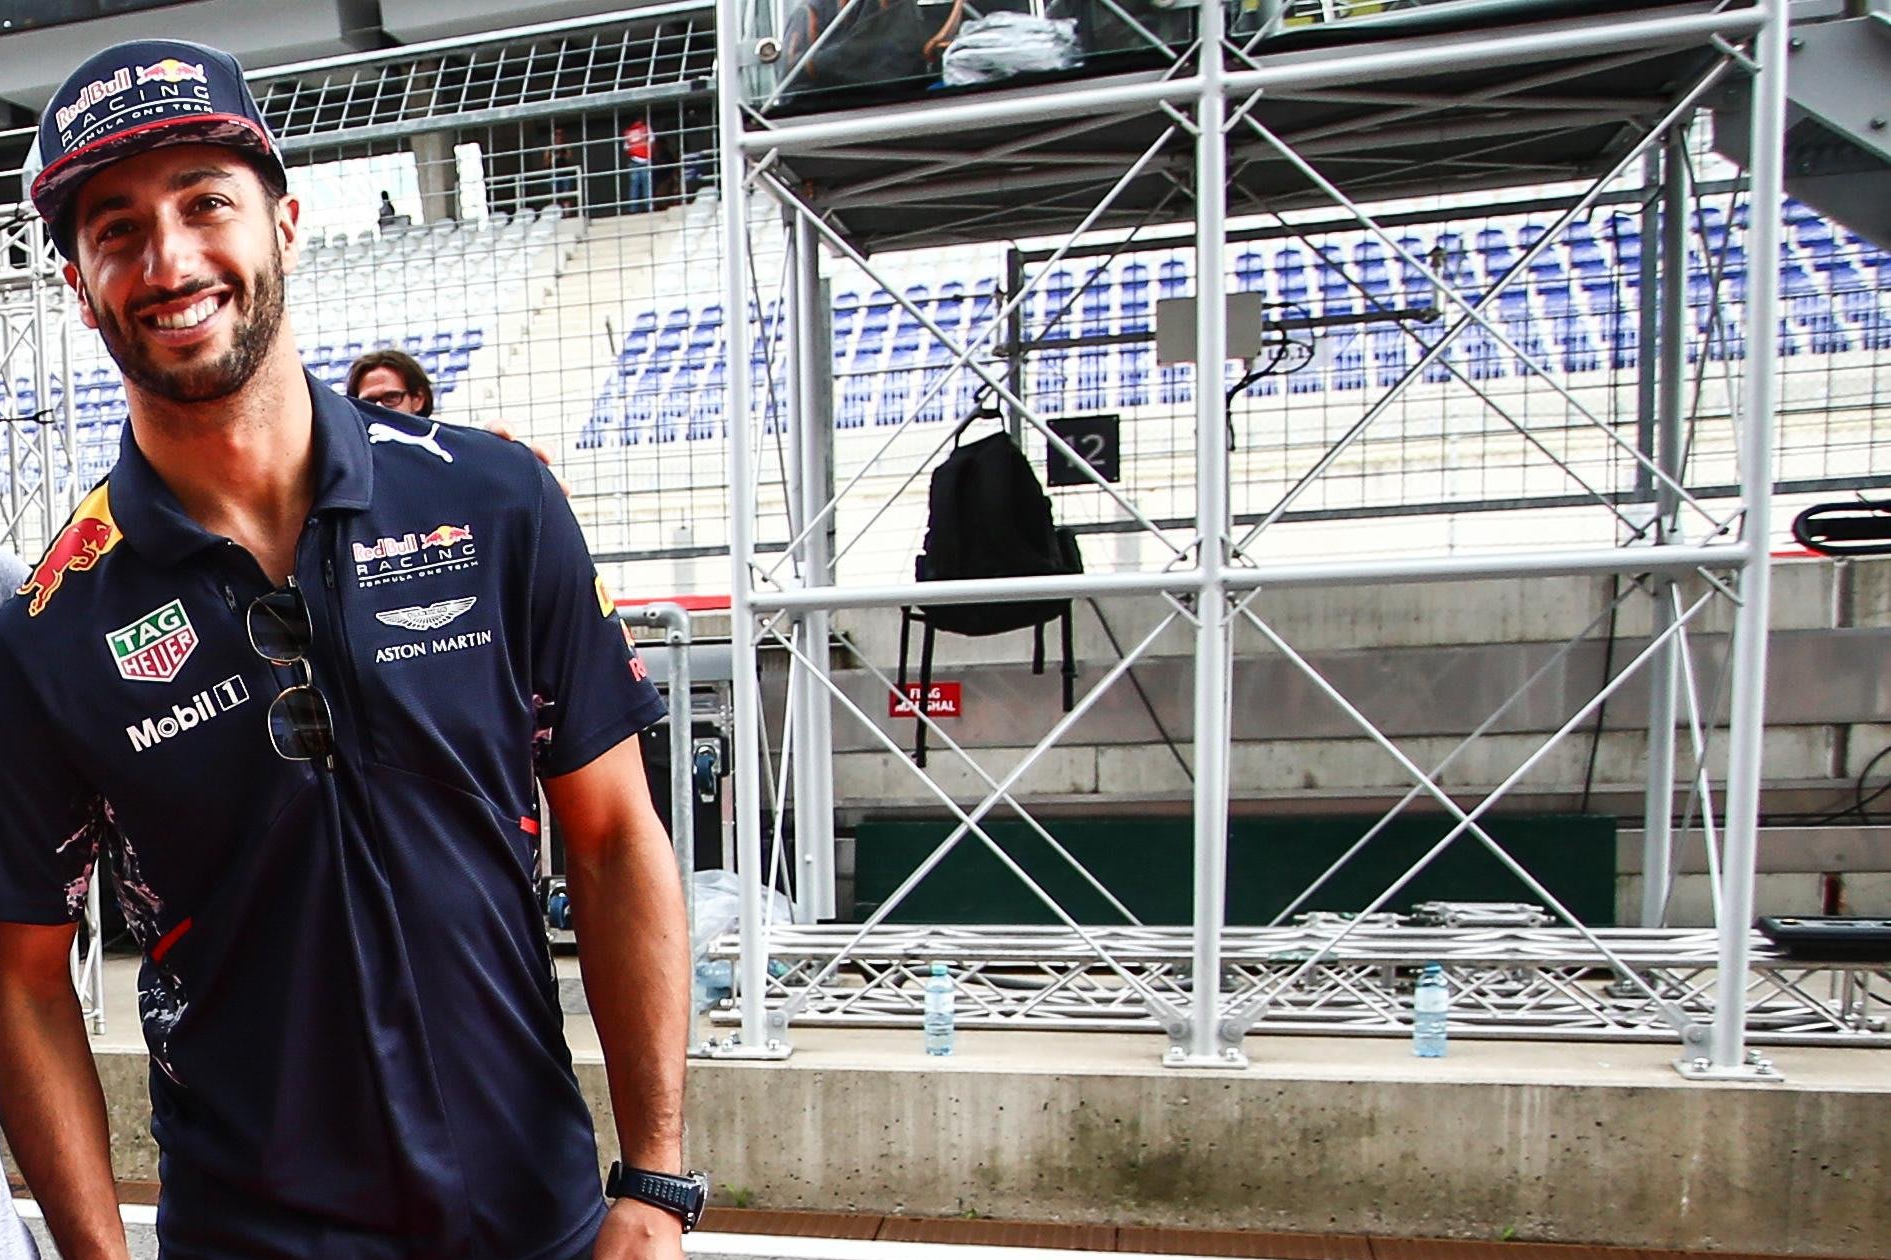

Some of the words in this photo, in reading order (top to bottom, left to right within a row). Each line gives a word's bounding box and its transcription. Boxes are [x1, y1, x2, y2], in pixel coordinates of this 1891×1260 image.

[61, 84, 210, 147] RACING
[72, 117, 125, 152] ORMULA
[131, 105, 164, 119] ONE
[172, 103, 214, 114] TEAM
[356, 543, 476, 576] RACING
[359, 574, 413, 588] FORMULA
[418, 567, 442, 578] ONE
[447, 560, 479, 572] TEAM
[114, 608, 182, 652] TAG
[375, 642, 427, 663] ASTON
[432, 630, 492, 653] MARTIN
[123, 632, 192, 676] HEUER
[910, 688, 941, 700] FLG
[125, 690, 217, 752] Mobil
